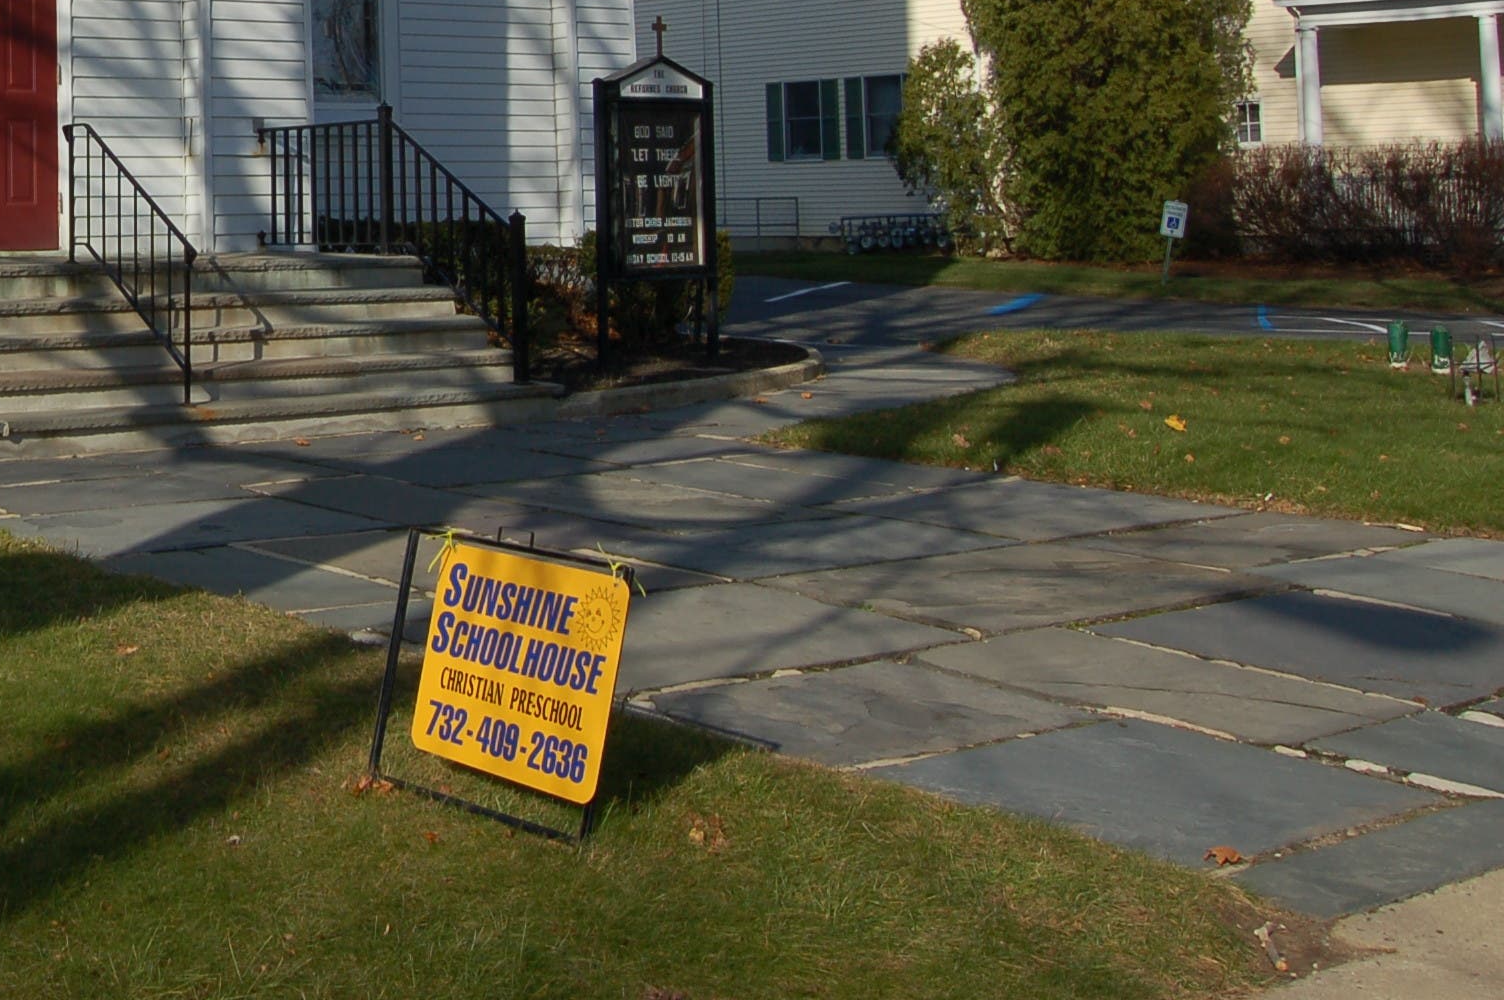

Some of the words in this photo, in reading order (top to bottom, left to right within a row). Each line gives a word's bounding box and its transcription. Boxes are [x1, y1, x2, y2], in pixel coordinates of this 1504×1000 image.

[634, 125, 650, 138] GOD
[655, 125, 673, 138] SAID
[636, 174, 648, 188] BE
[443, 562, 578, 635] SUNSHINE
[431, 611, 606, 695] SCHOOLHOUSE
[440, 666, 504, 706] CHRISTIAN
